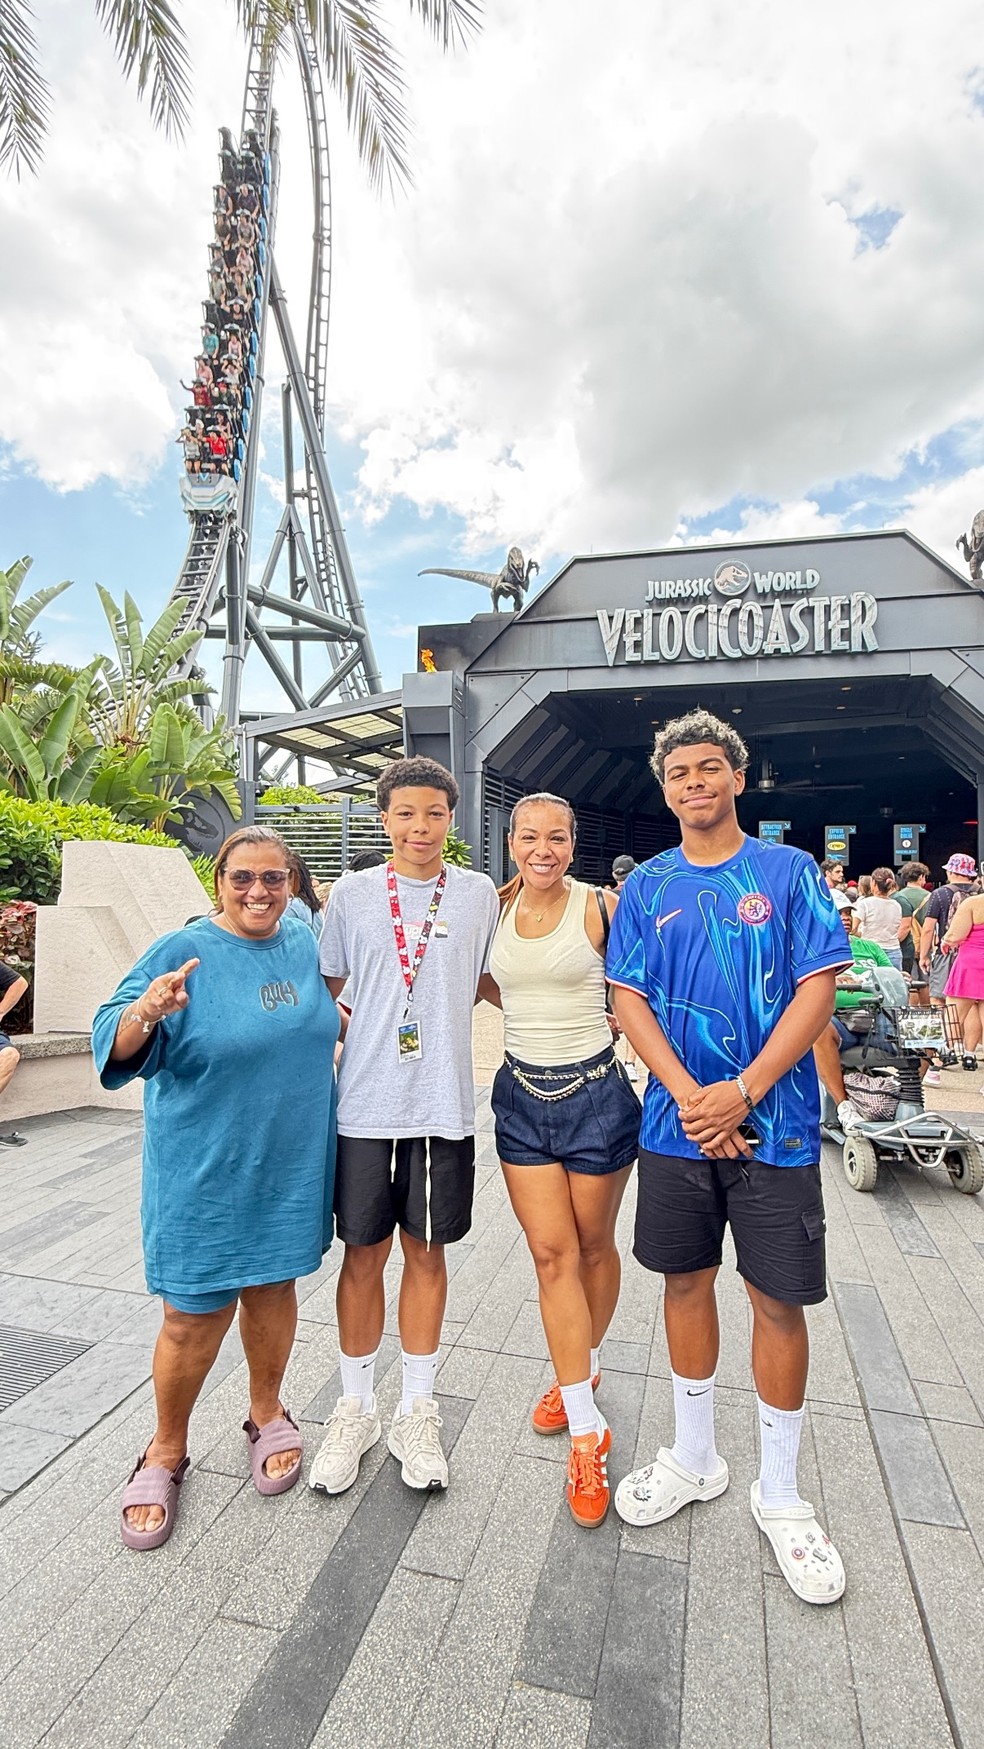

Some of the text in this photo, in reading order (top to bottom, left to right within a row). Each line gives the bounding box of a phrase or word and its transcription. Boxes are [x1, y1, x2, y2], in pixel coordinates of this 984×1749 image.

[645, 569, 820, 601] JURASSIC WORLD
[596, 592, 880, 667] VELOCICOASTER
